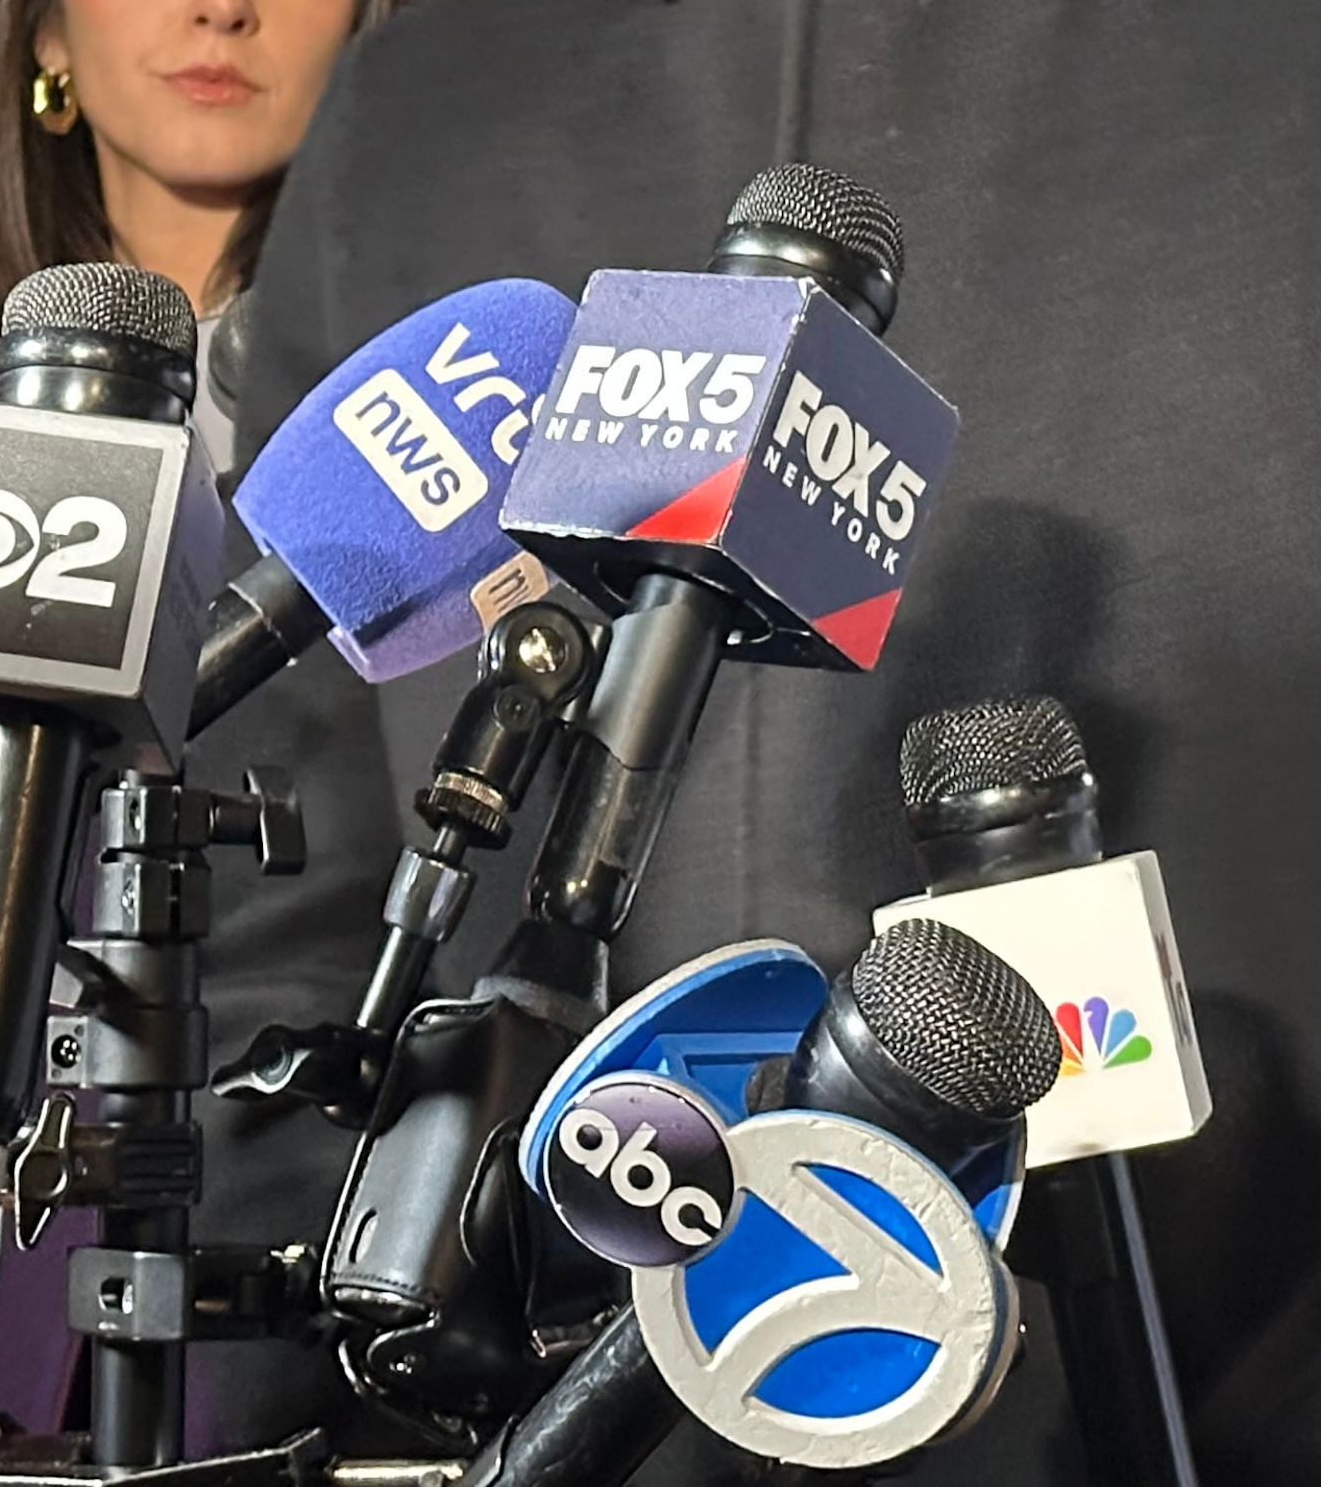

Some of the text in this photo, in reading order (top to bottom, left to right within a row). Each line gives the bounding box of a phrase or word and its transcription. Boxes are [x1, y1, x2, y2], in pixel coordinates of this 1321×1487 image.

[355, 390, 461, 507] nws
[545, 417, 739, 453] NEW YORK
[763, 446, 901, 576] NEW YORK
[558, 1107, 722, 1248] abc
